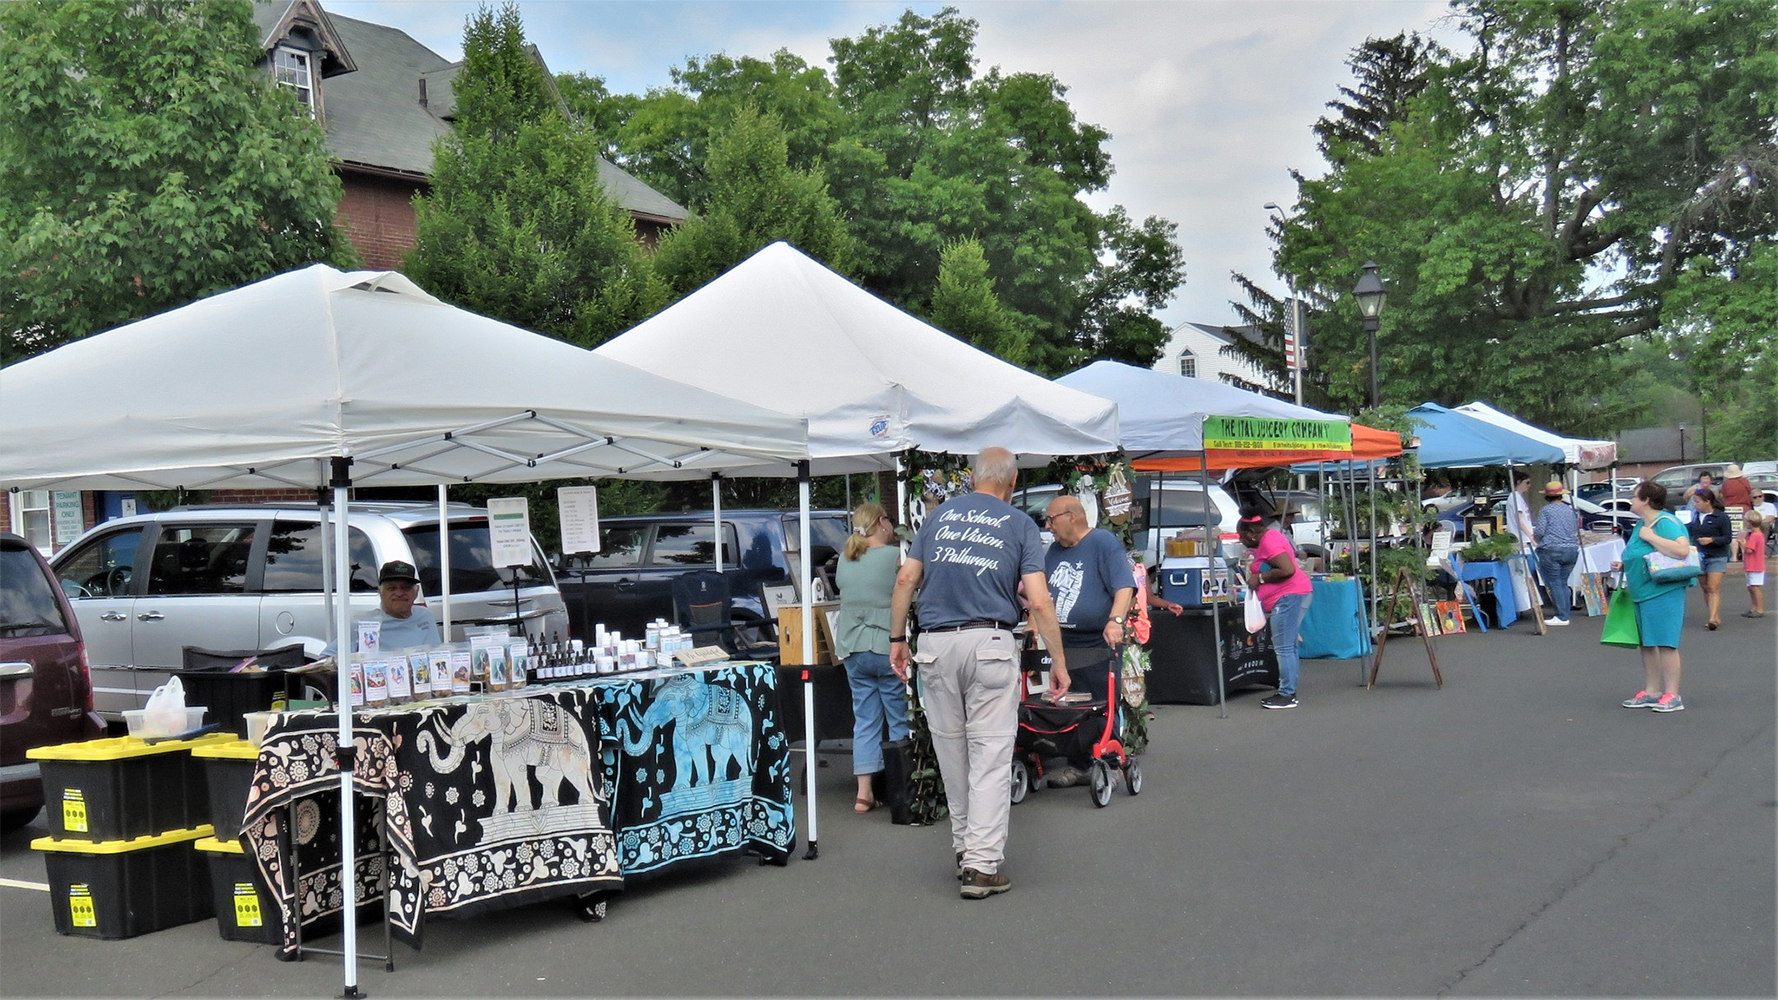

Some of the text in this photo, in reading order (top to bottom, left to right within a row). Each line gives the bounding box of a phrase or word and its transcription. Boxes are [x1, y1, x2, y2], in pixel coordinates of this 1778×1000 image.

[1221, 419, 1330, 439] THE ITAL JUICERY COMPANY
[55, 501, 80, 509] PARKING
[939, 508, 1011, 528] One School.
[935, 525, 1005, 549] One Vision.
[931, 546, 999, 576] 3 Pathways.
